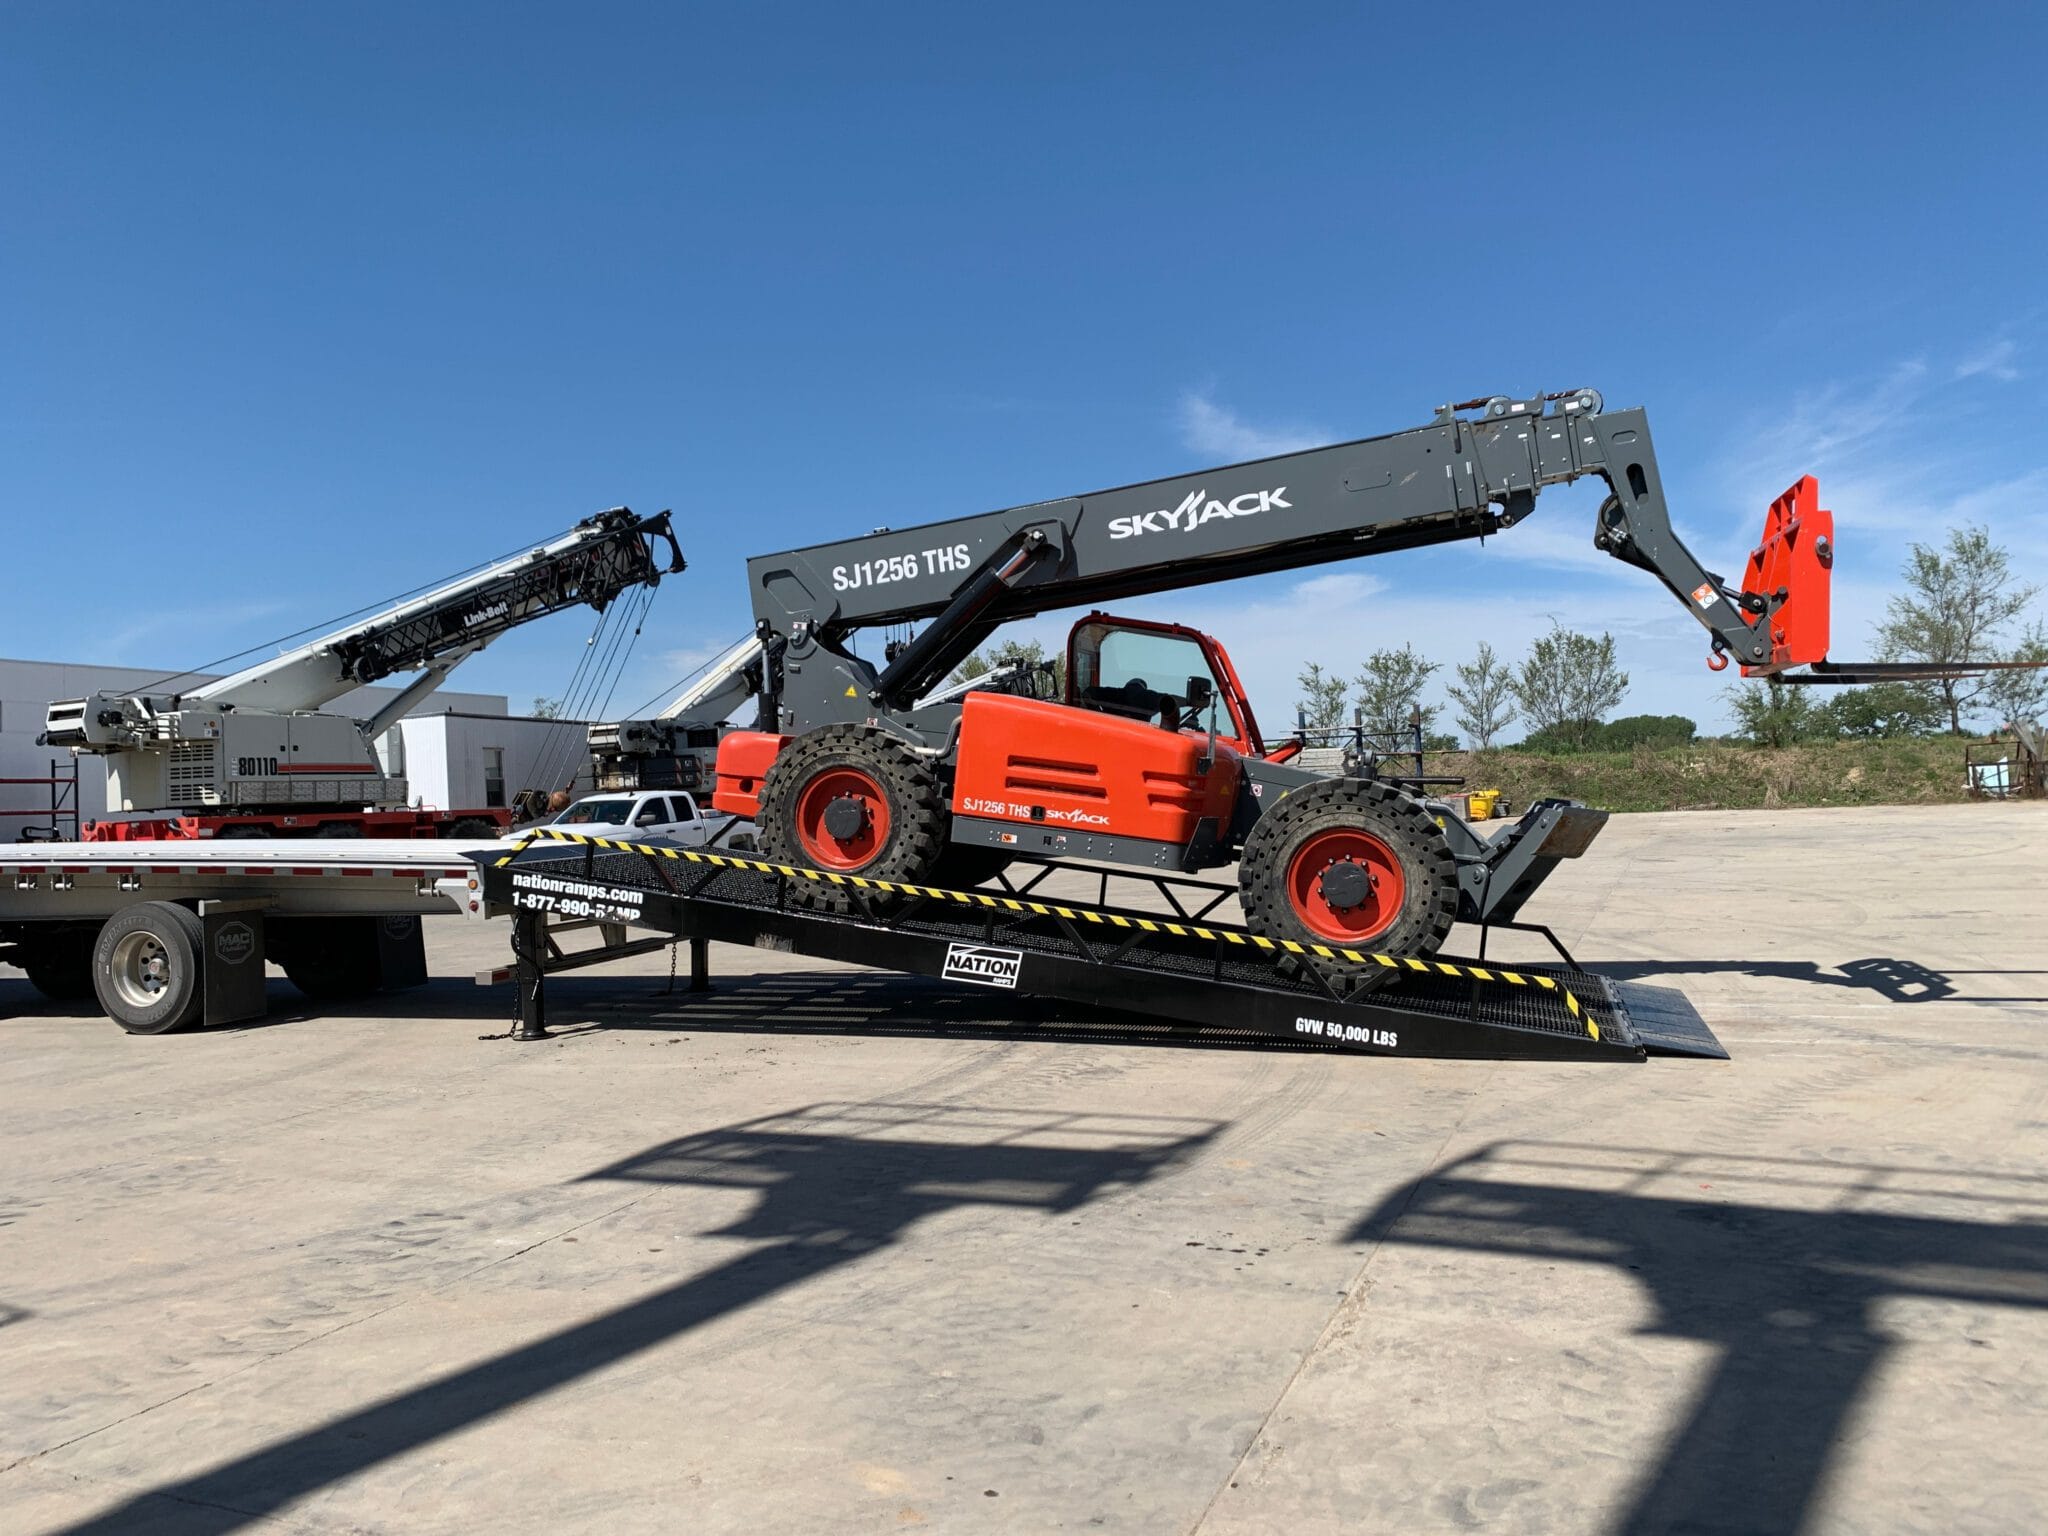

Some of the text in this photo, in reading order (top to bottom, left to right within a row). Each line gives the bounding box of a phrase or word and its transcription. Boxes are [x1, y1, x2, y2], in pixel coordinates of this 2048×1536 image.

[1108, 487, 1293, 539] SKYJACK
[832, 543, 971, 591] SJ1256 THS
[463, 601, 508, 627] Link-Belt
[238, 757, 278, 776] 80110
[963, 797, 1110, 825] SJ1256 THS SKYJACK
[512, 874, 643, 904] nationramps.com
[947, 954, 1018, 977] NATION
[1295, 1017, 1398, 1047] GVW 50,000 LBS
